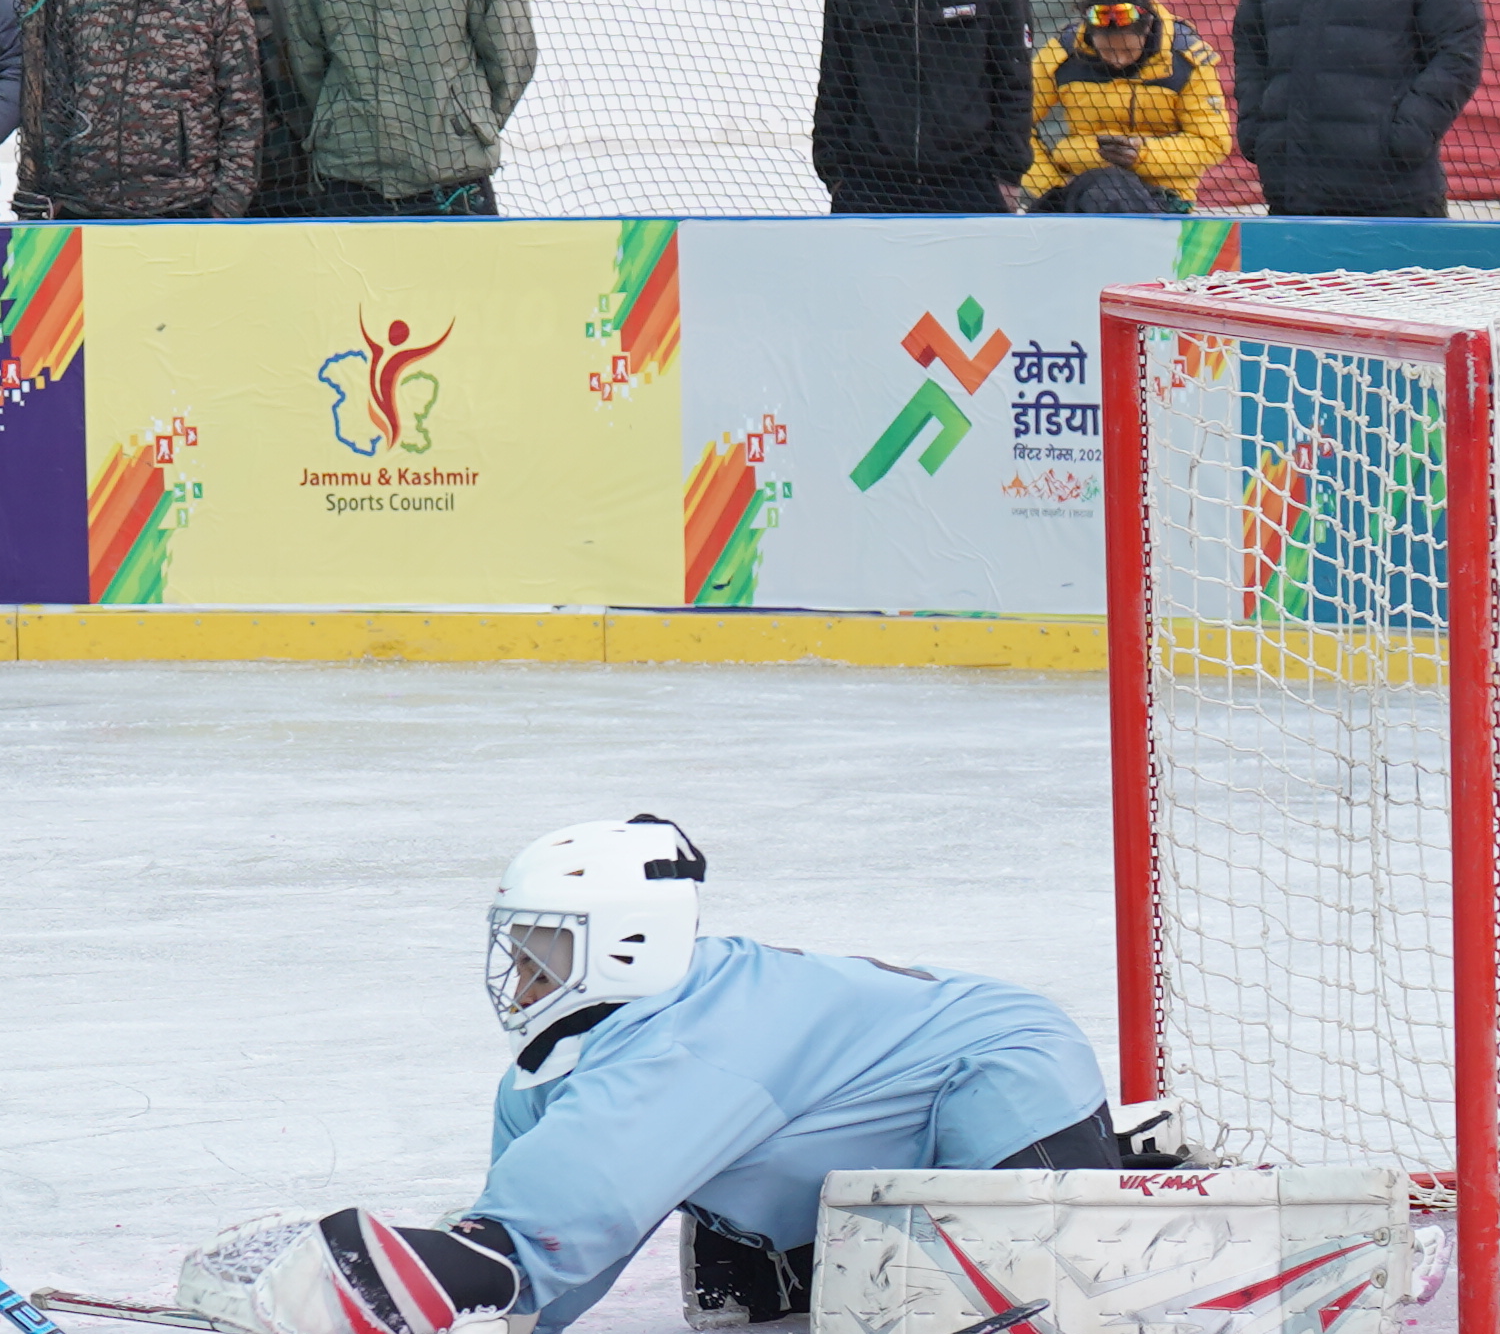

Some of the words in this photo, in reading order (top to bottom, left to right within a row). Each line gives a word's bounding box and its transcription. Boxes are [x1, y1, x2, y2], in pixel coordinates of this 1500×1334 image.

[1012, 340, 1087, 384] खेलो
[1012, 390, 1100, 438] इंडिया
[1079, 449, 1102, 462] 202
[300, 468, 372, 487] Jammu
[377, 468, 393, 485] &
[398, 467, 479, 486] Kashmir
[326, 493, 384, 515] Sports
[389, 492, 455, 512] Council
[1119, 1173, 1221, 1197] VIK-MAX
